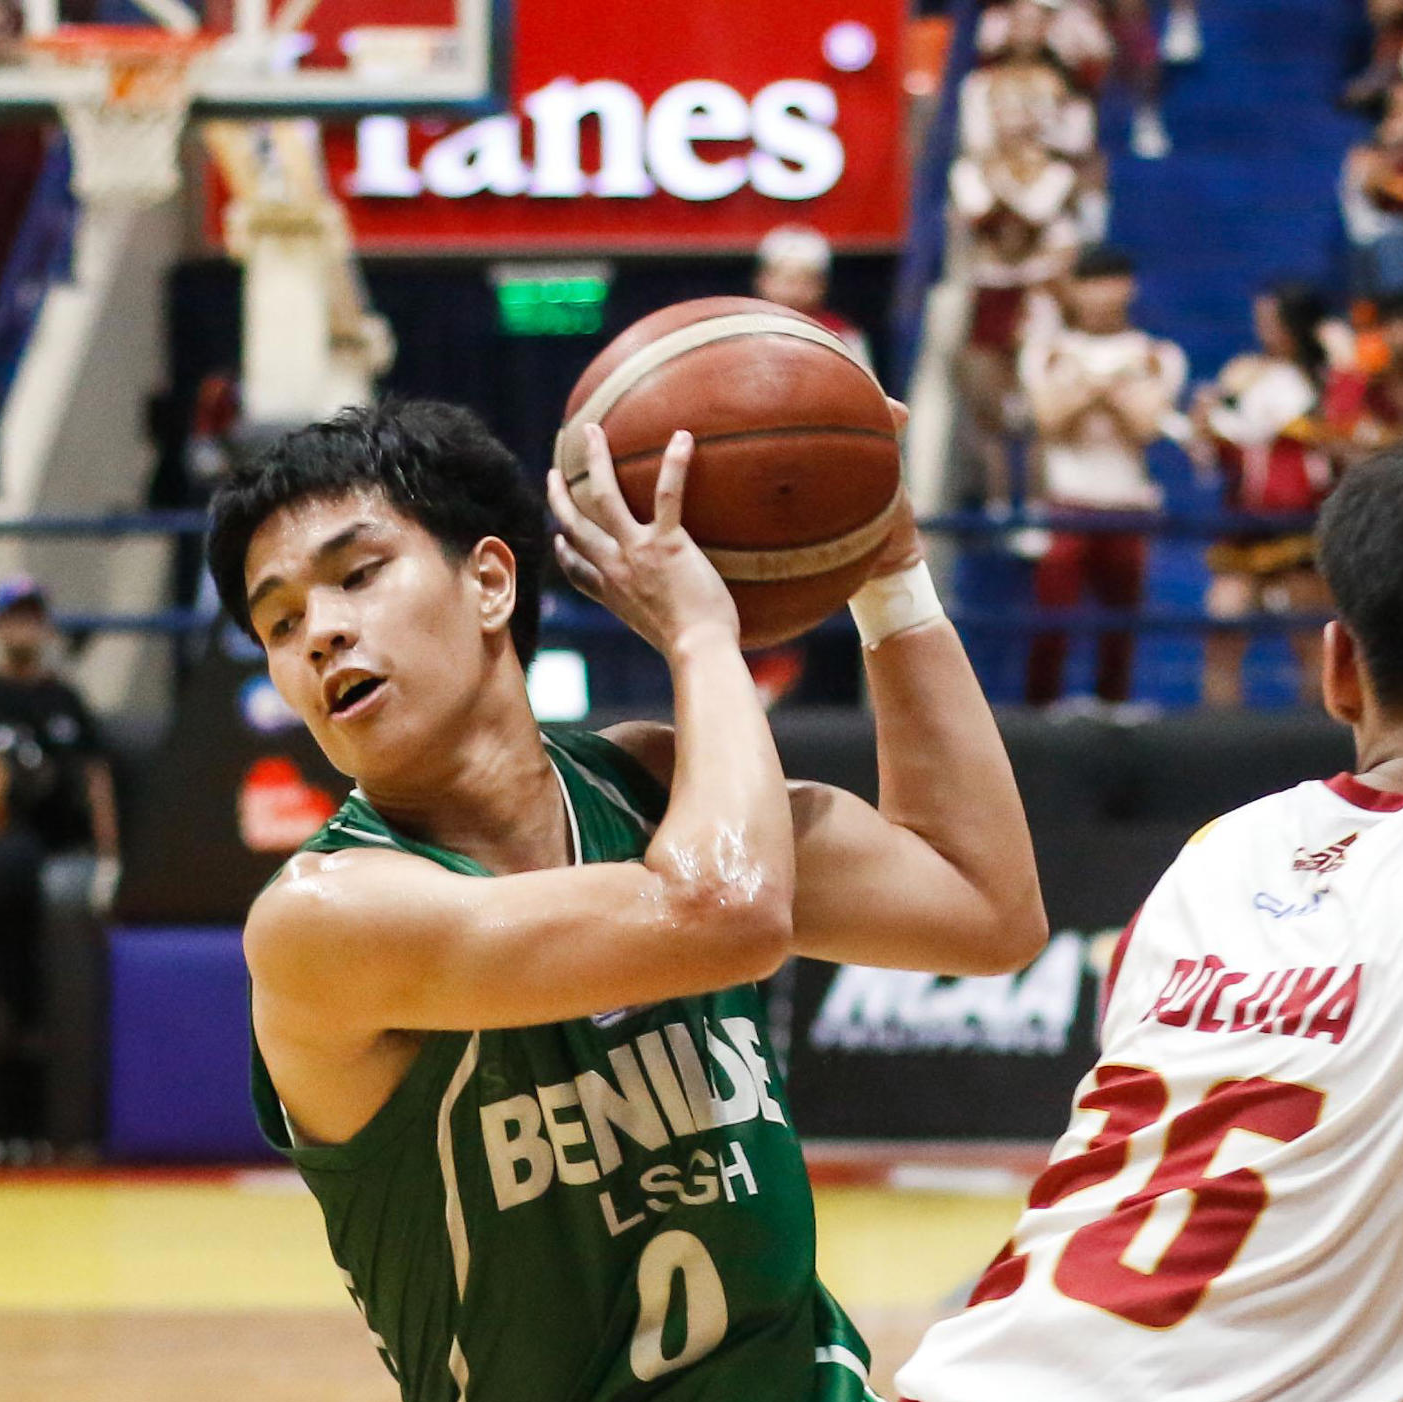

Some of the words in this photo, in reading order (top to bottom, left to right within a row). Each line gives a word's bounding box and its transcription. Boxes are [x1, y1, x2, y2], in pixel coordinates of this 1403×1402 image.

[479, 1016, 788, 1212] BENILDE
[599, 1140, 759, 1237] LSGH
[965, 1063, 1327, 1331] 26
[629, 1229, 729, 1383] 0
